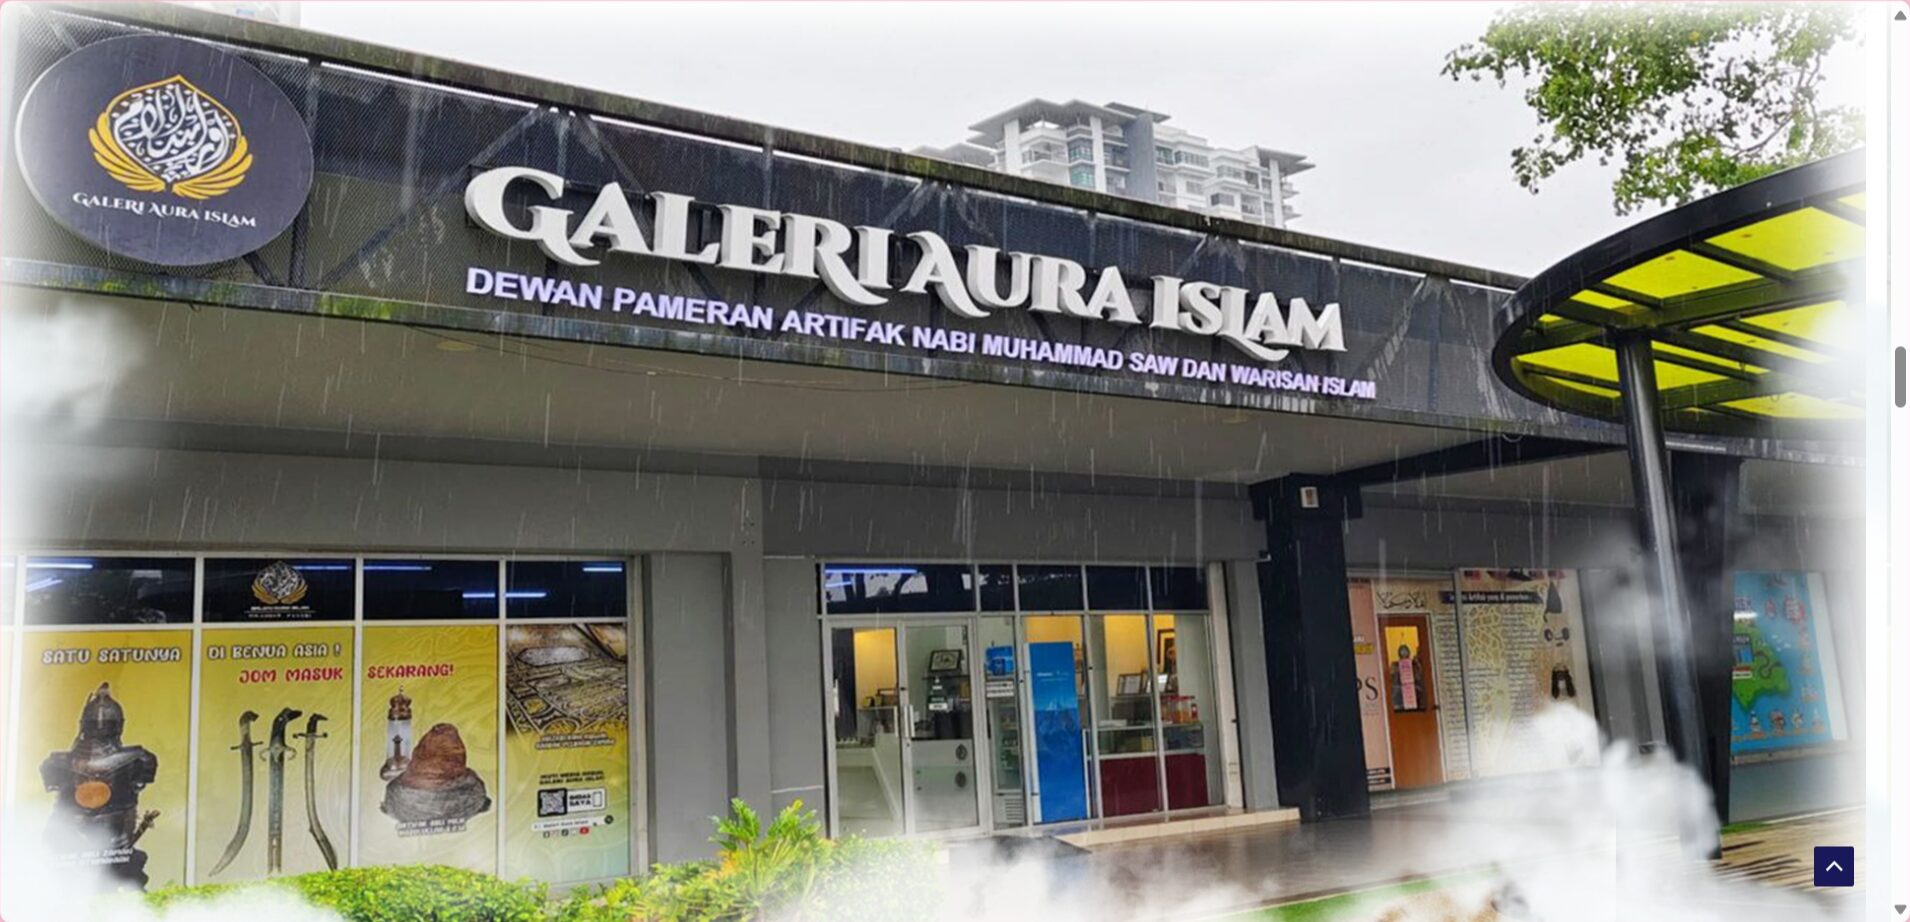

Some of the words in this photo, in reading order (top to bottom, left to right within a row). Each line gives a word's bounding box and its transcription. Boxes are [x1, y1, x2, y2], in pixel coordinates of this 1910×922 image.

[72, 192, 146, 215] GALERI
[149, 202, 199, 218] AURA
[204, 210, 257, 228] ISLAM
[464, 165, 889, 306] GALERI
[901, 230, 1142, 324] AURA
[1149, 274, 1348, 362] ISLAM
[466, 266, 602, 309] DEWAN
[612, 286, 774, 331] PAMERAN
[780, 308, 905, 347] ARTIFAK
[912, 327, 975, 355] NABI
[982, 334, 1124, 371] MUHAMMAD
[1128, 351, 1182, 378] SAW
[1182, 359, 1226, 384] DAN
[1231, 364, 1318, 394] WARISAN
[1321, 376, 1377, 399] ISLAM
[43, 648, 91, 664] SATU
[97, 647, 182, 663] SATUNYA
[208, 645, 226, 660] DI
[232, 645, 287, 659] BENUA
[294, 643, 328, 657] ASIA
[334, 643, 342, 656] !
[239, 669, 277, 684] JOM
[285, 667, 343, 682] MASUK
[367, 663, 455, 679] SEKARANG!
